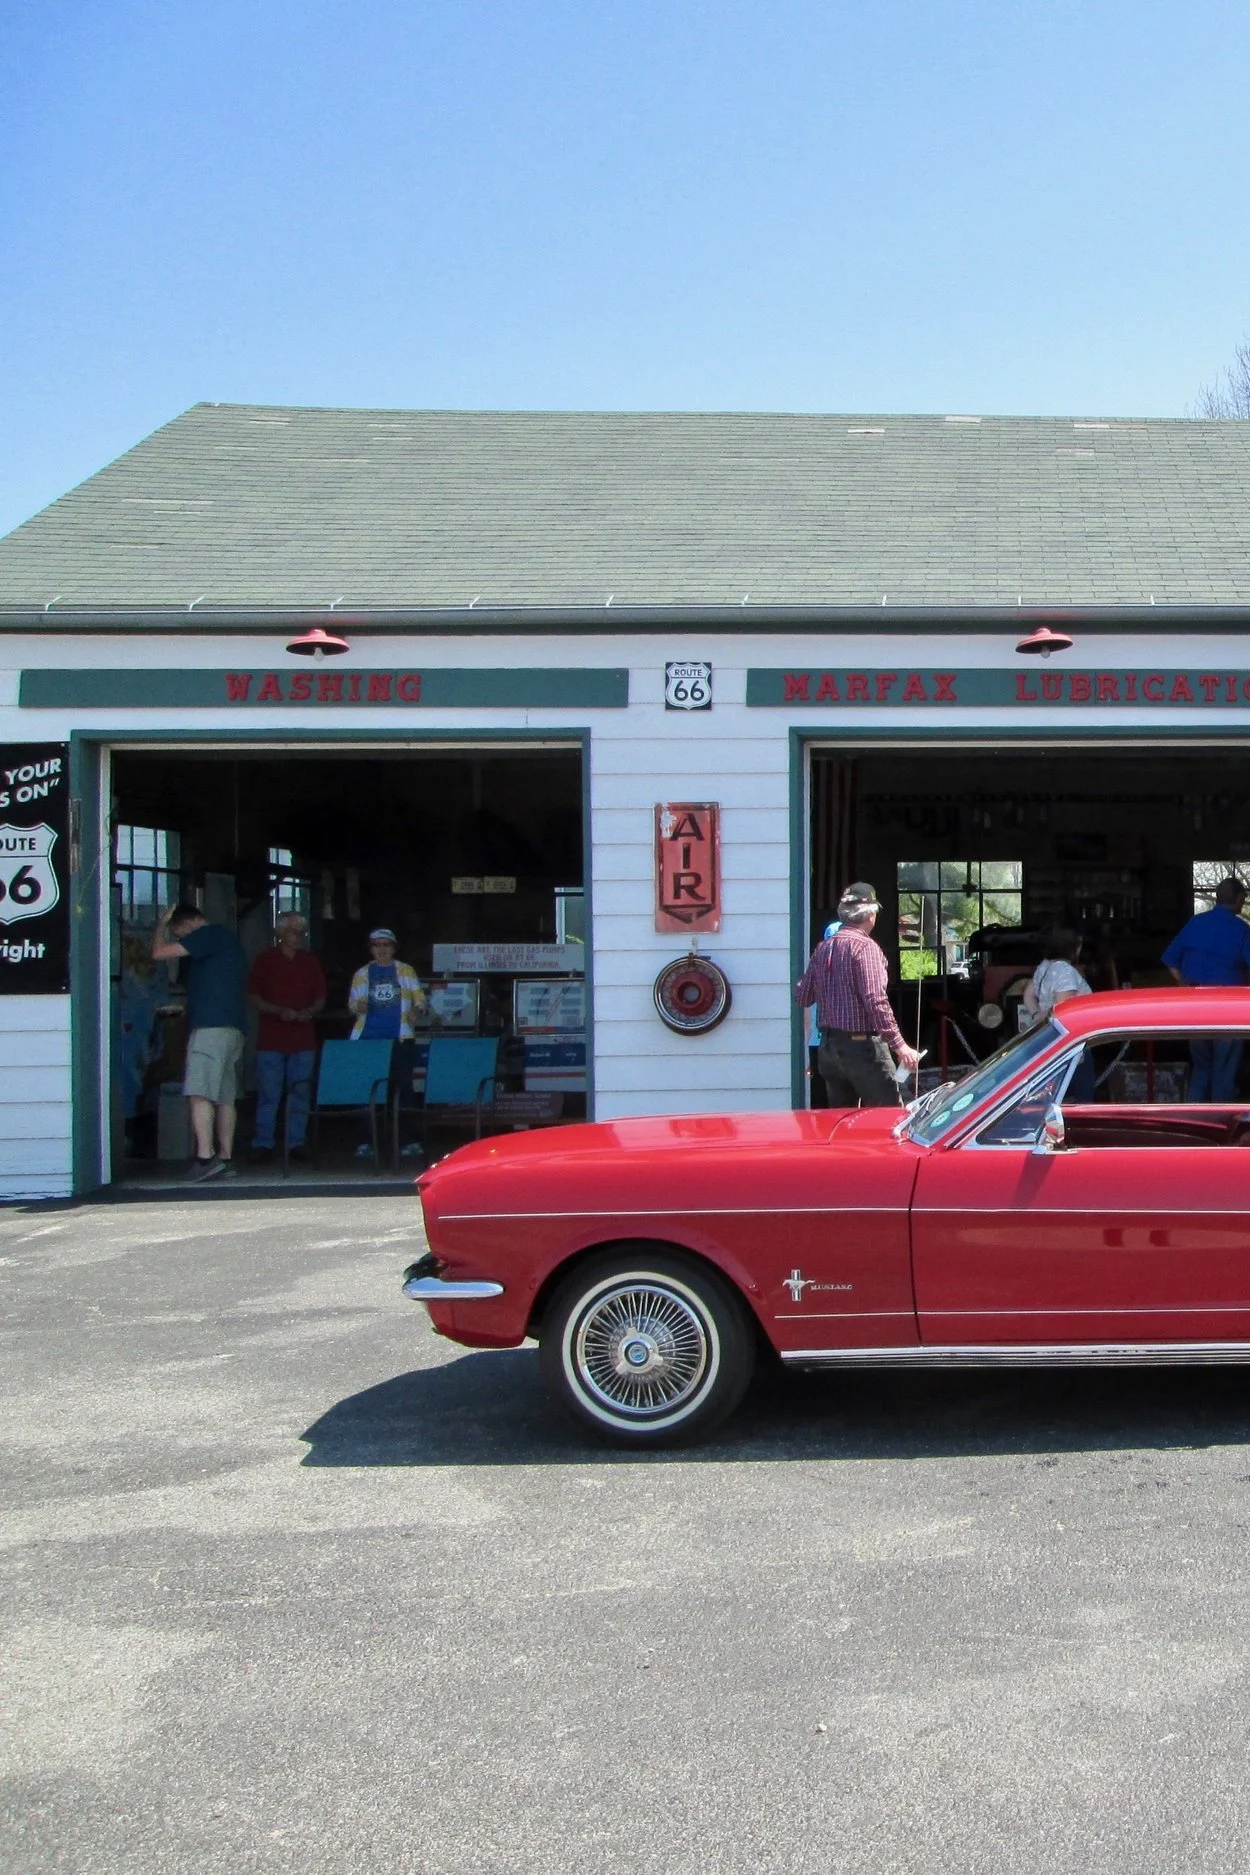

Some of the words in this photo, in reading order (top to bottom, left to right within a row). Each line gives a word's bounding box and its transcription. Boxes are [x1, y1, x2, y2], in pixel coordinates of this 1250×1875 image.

[225, 673, 422, 703] WASHING
[674, 680, 705, 702] 66
[782, 672, 958, 701] MARFAX
[5, 758, 62, 785] YOUR
[669, 812, 706, 901] AIR
[0, 865, 42, 905] 6
[0, 939, 46, 963] ight
[377, 990, 392, 999] 66
